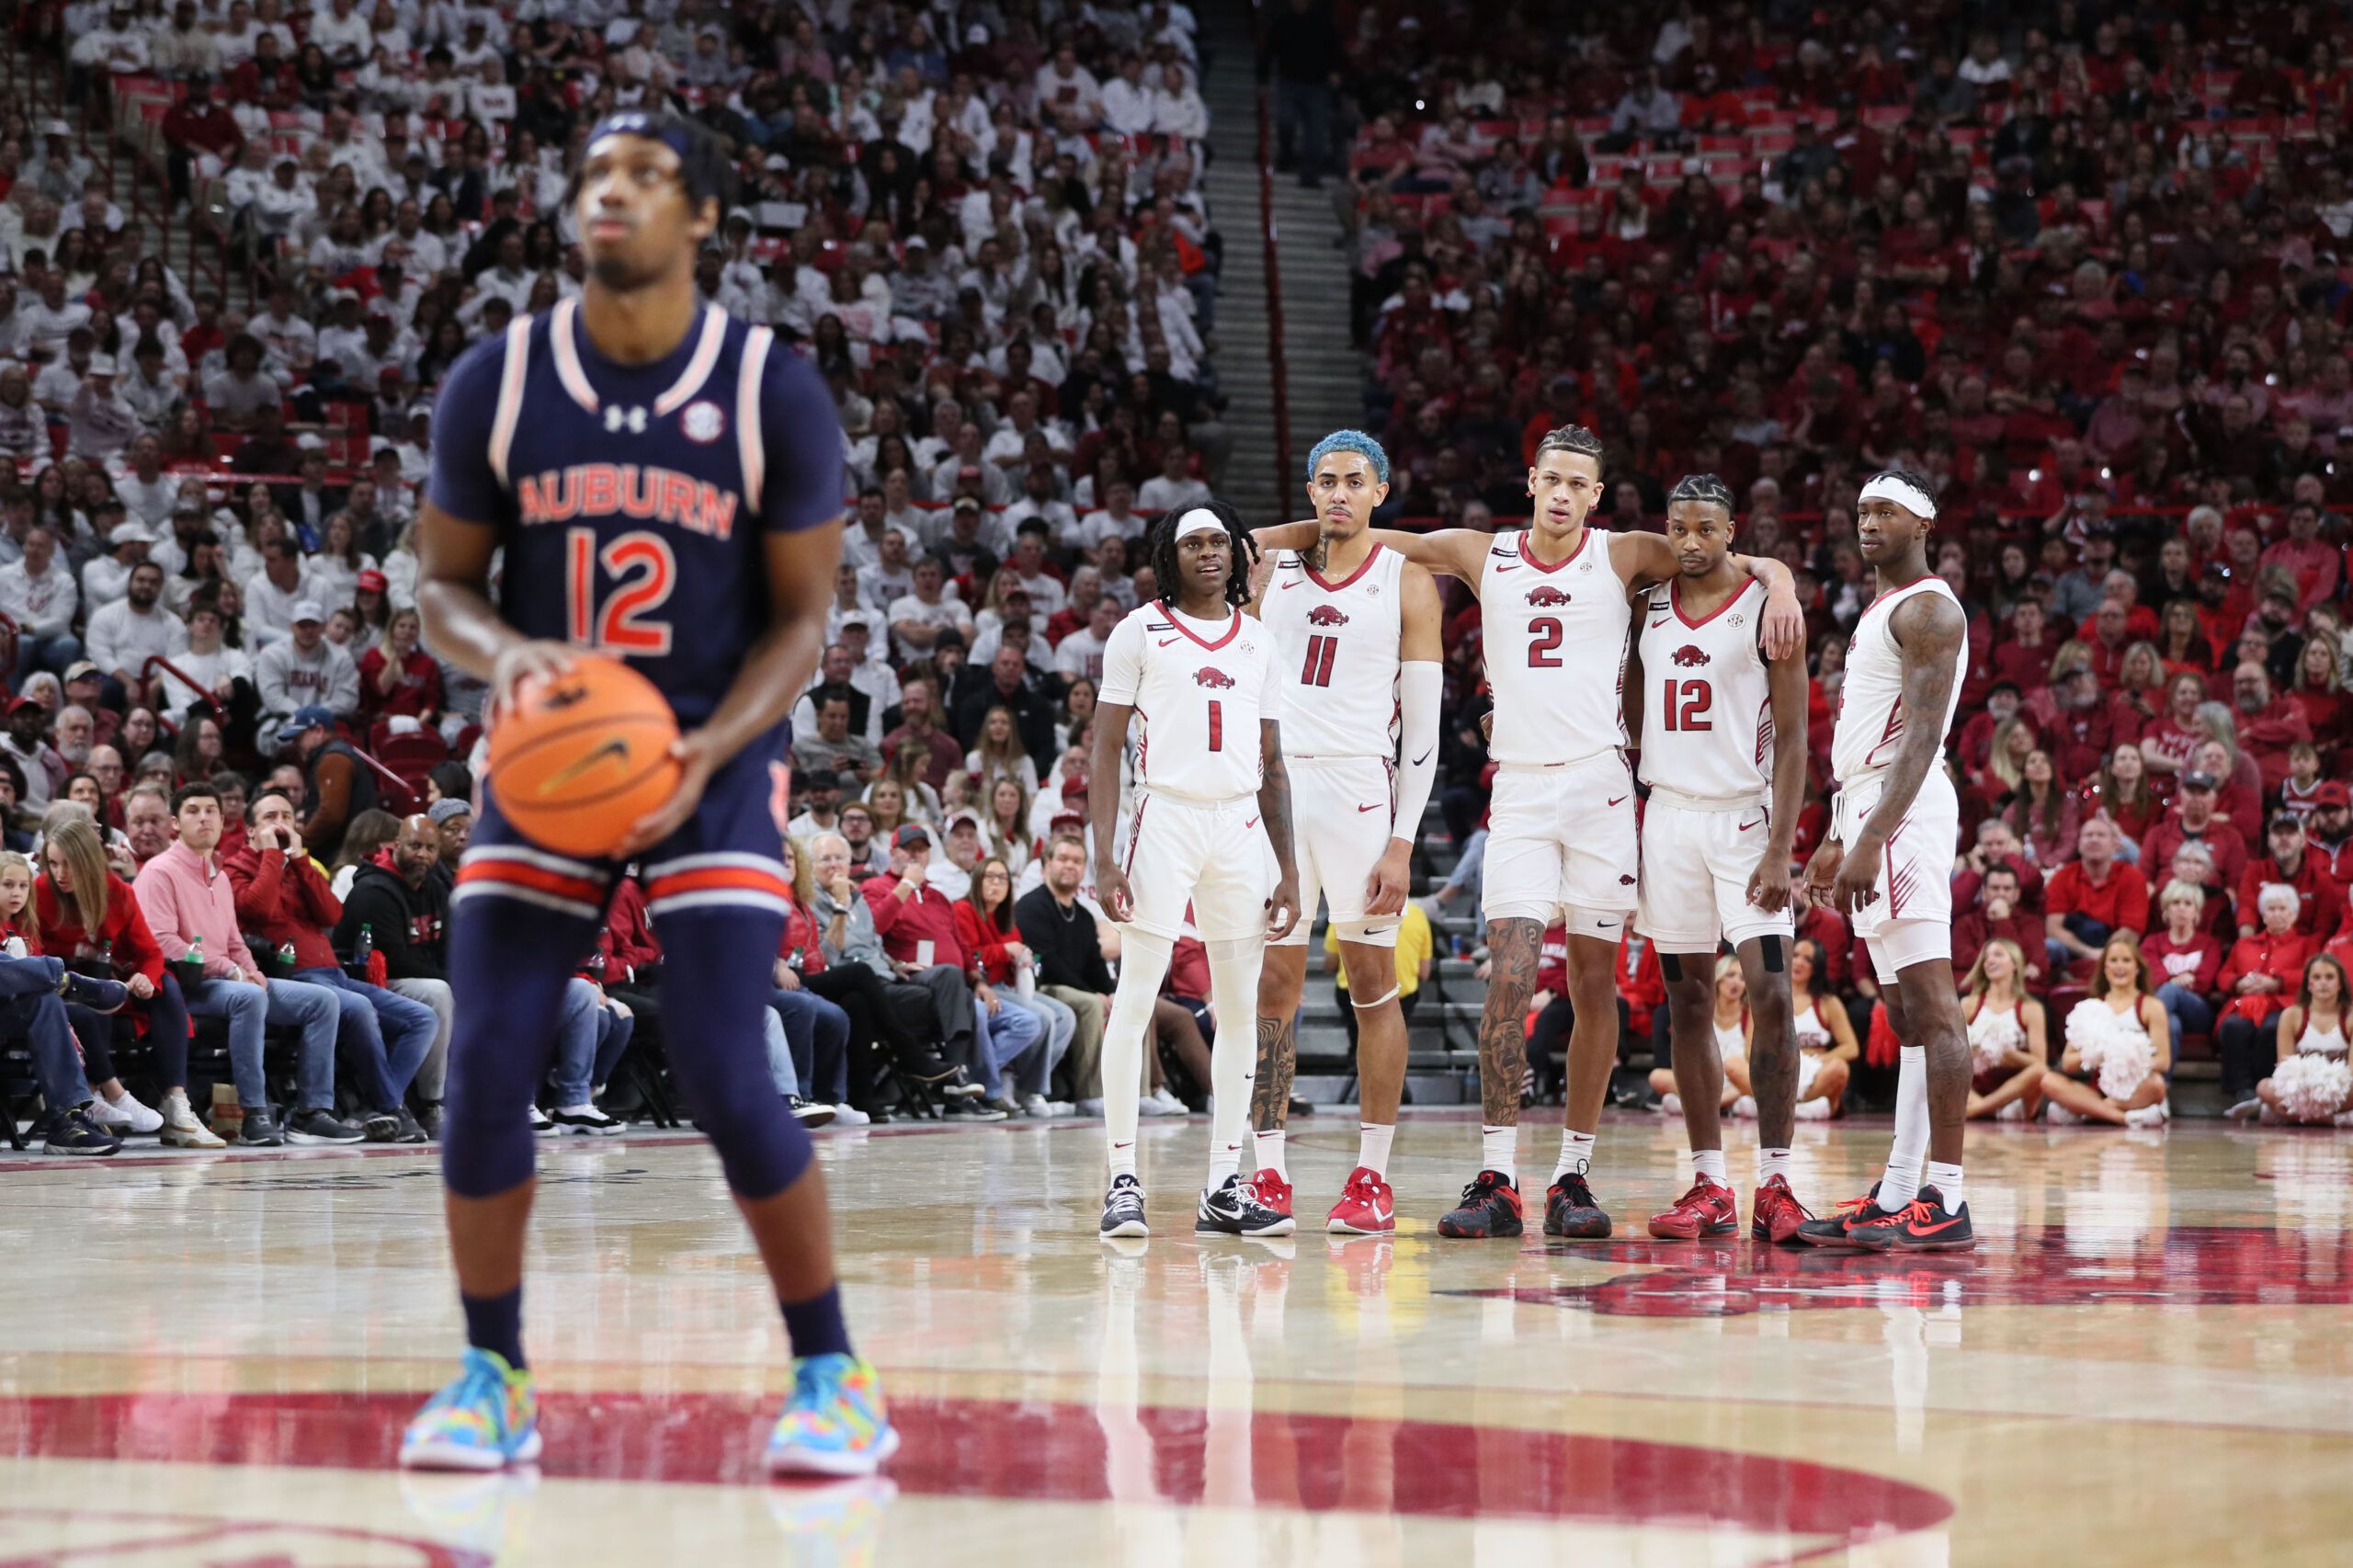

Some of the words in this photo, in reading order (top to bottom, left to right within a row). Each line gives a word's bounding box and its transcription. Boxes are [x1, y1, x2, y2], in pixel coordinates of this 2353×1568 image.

[516, 462, 739, 541] AUBURN
[566, 527, 676, 655] 12
[1301, 634, 1338, 687] 11
[1529, 617, 1563, 667] 2
[1208, 699, 1222, 752] 1
[1664, 679, 1711, 731] 12
